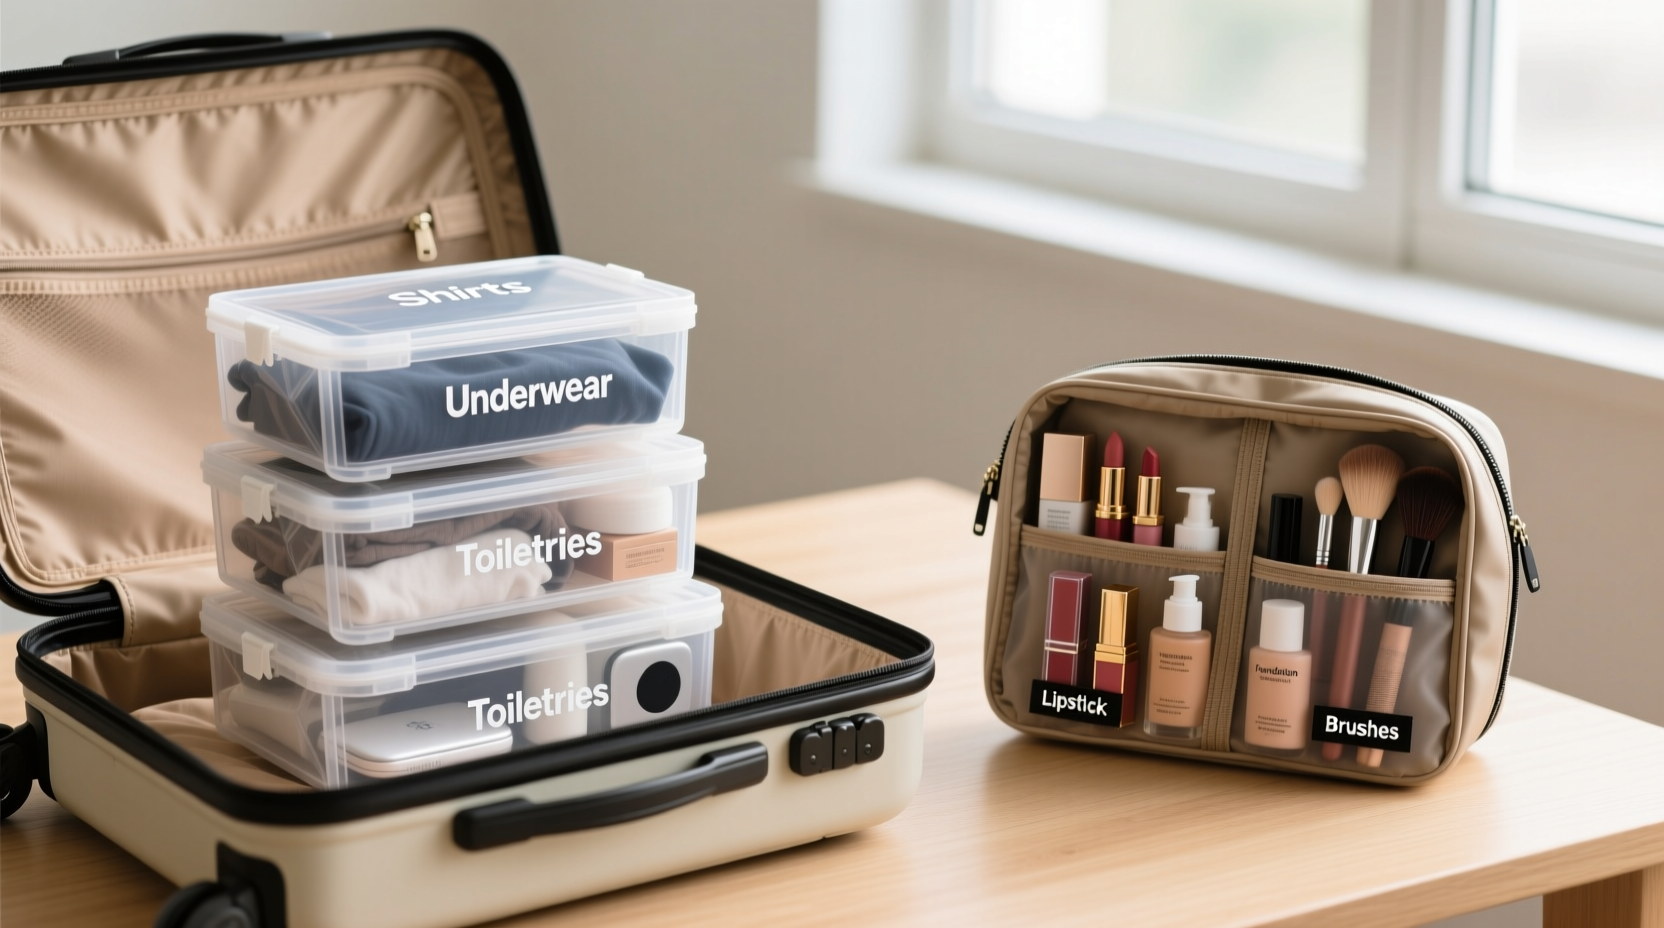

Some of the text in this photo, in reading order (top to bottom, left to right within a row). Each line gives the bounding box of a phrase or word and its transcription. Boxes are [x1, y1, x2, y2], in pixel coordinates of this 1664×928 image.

[388, 280, 532, 307] Shirts
[446, 372, 613, 418] Underwear
[456, 528, 602, 576] Toiletries
[468, 681, 610, 731] Toiletries
[1041, 689, 1108, 718] Lipstick
[1325, 714, 1400, 741] Brushes
